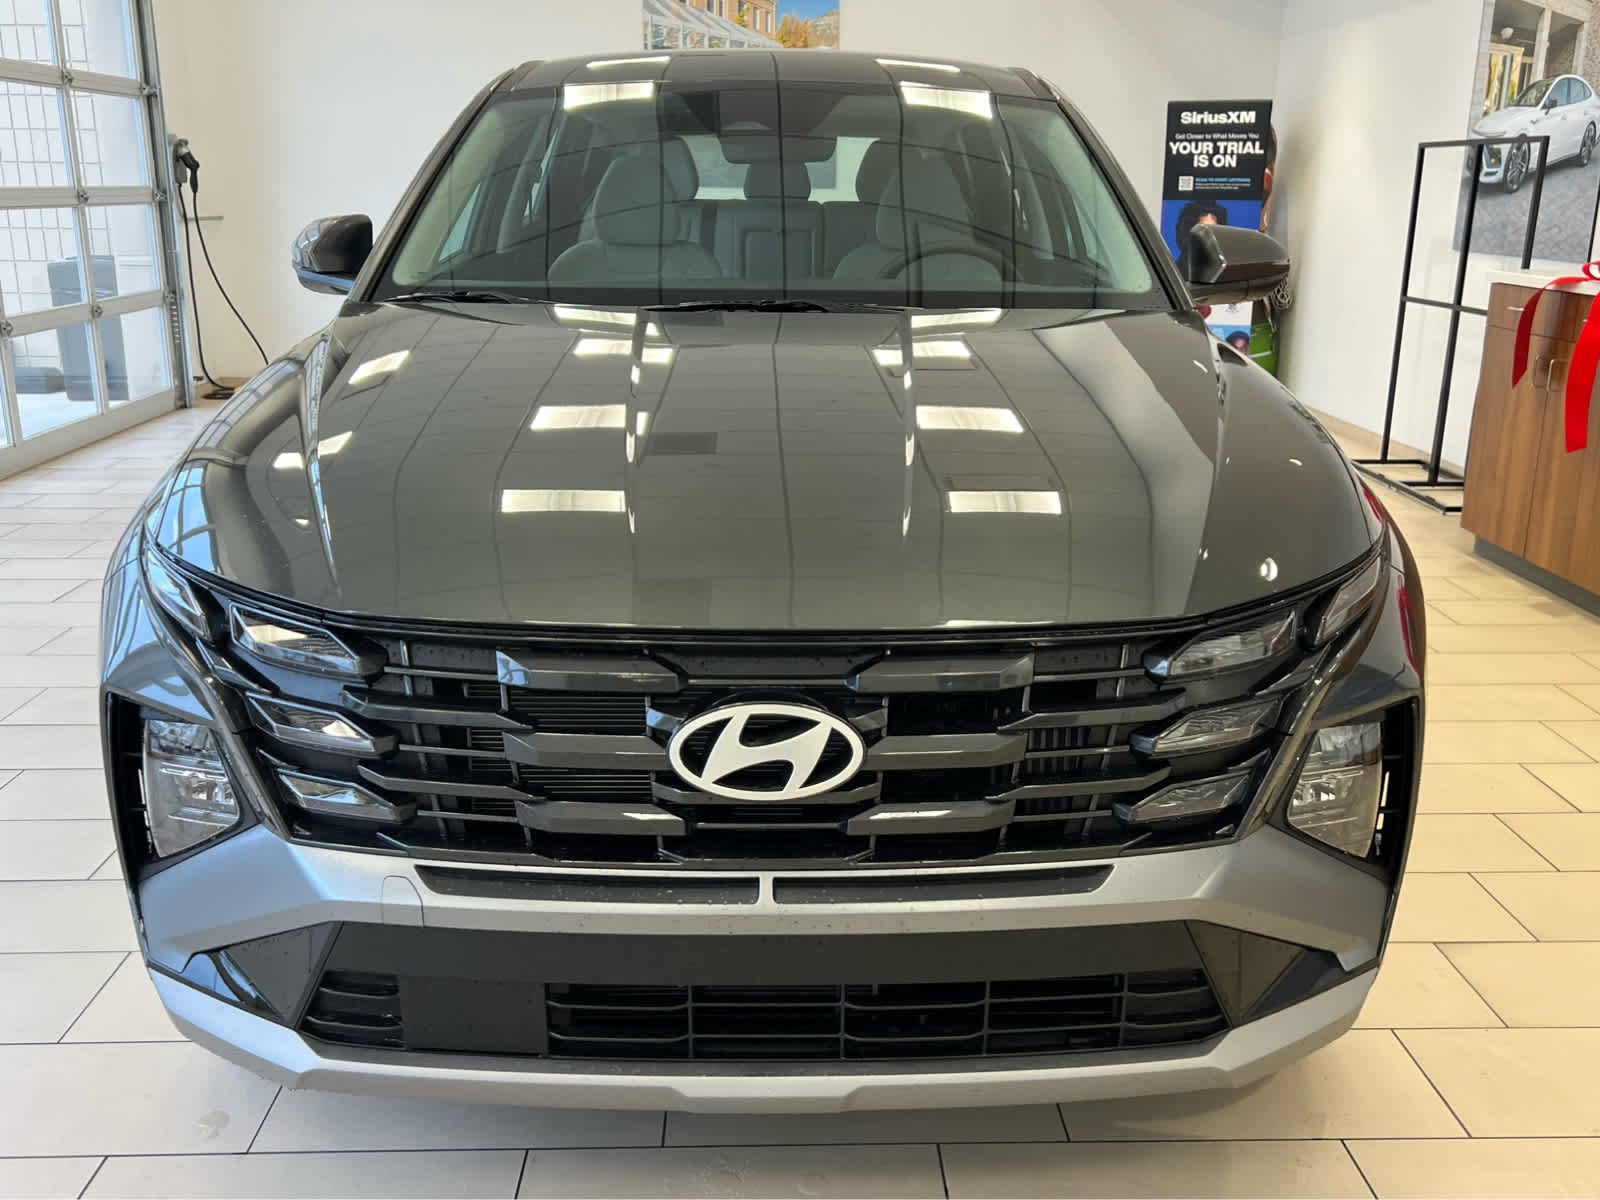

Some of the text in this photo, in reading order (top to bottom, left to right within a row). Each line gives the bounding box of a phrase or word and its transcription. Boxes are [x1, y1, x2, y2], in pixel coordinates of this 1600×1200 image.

[1180, 111, 1256, 124] SiriusXM
[1169, 141, 1265, 155] YOUR TRIAL
[1193, 154, 1237, 168] IS ON
